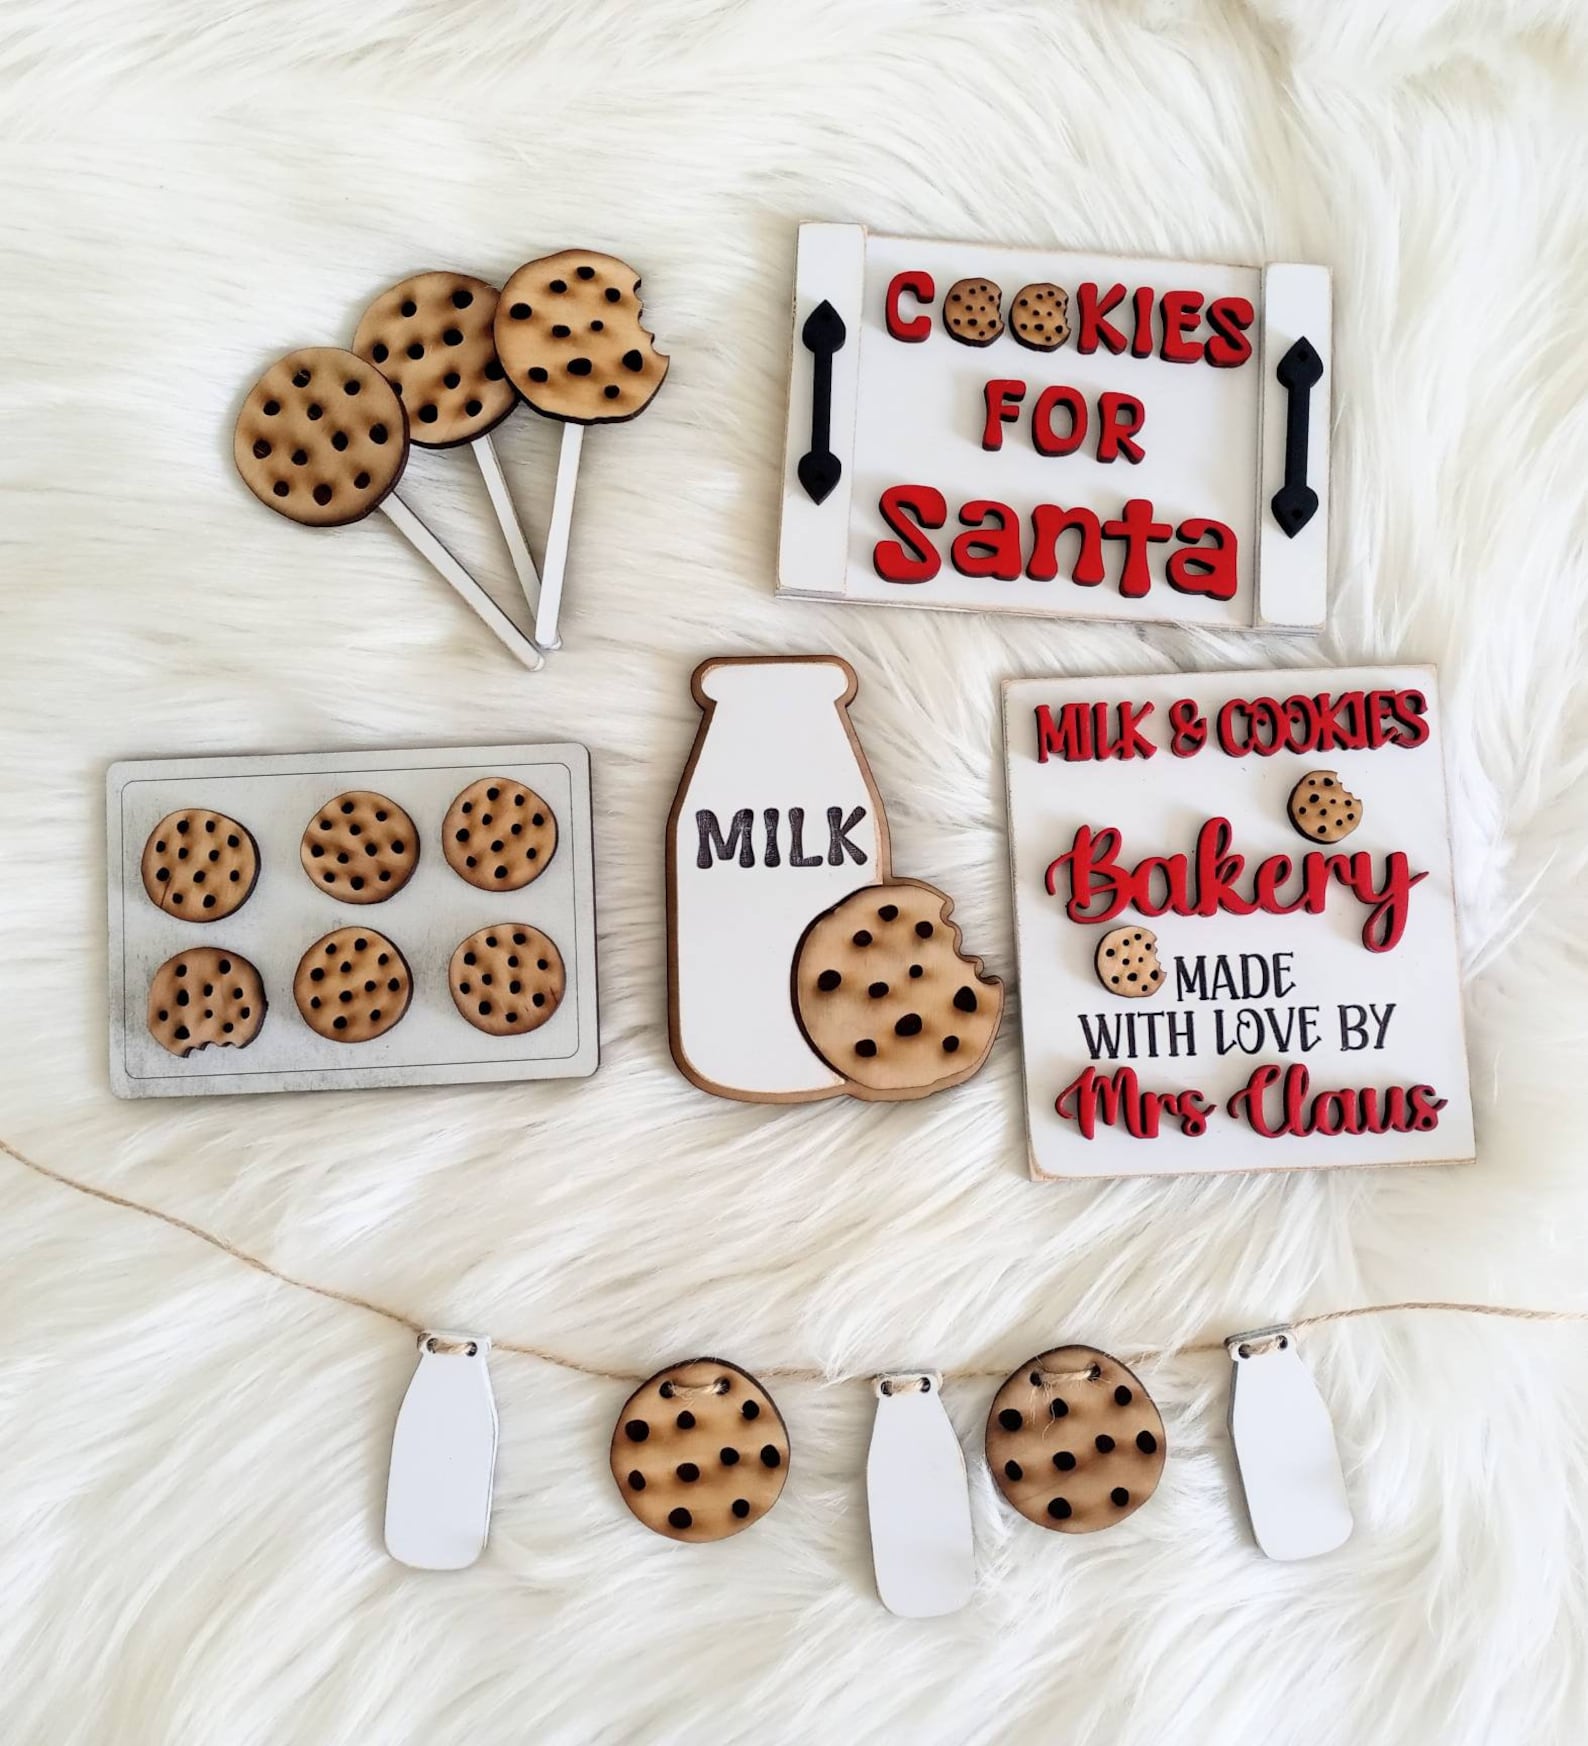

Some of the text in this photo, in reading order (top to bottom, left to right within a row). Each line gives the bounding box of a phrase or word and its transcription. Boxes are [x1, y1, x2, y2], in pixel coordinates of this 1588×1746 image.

[982, 379, 1145, 464] FOR
[873, 484, 1238, 600] Santa
[1034, 689, 1429, 762] MILK & COOKIES
[696, 806, 867, 869] MILK
[1045, 817, 1427, 952] Bakery
[1175, 953, 1295, 1002] MADE
[1078, 1004, 1395, 1059] WITH LOVE BY
[1055, 1063, 1446, 1139] Mrs Claus
